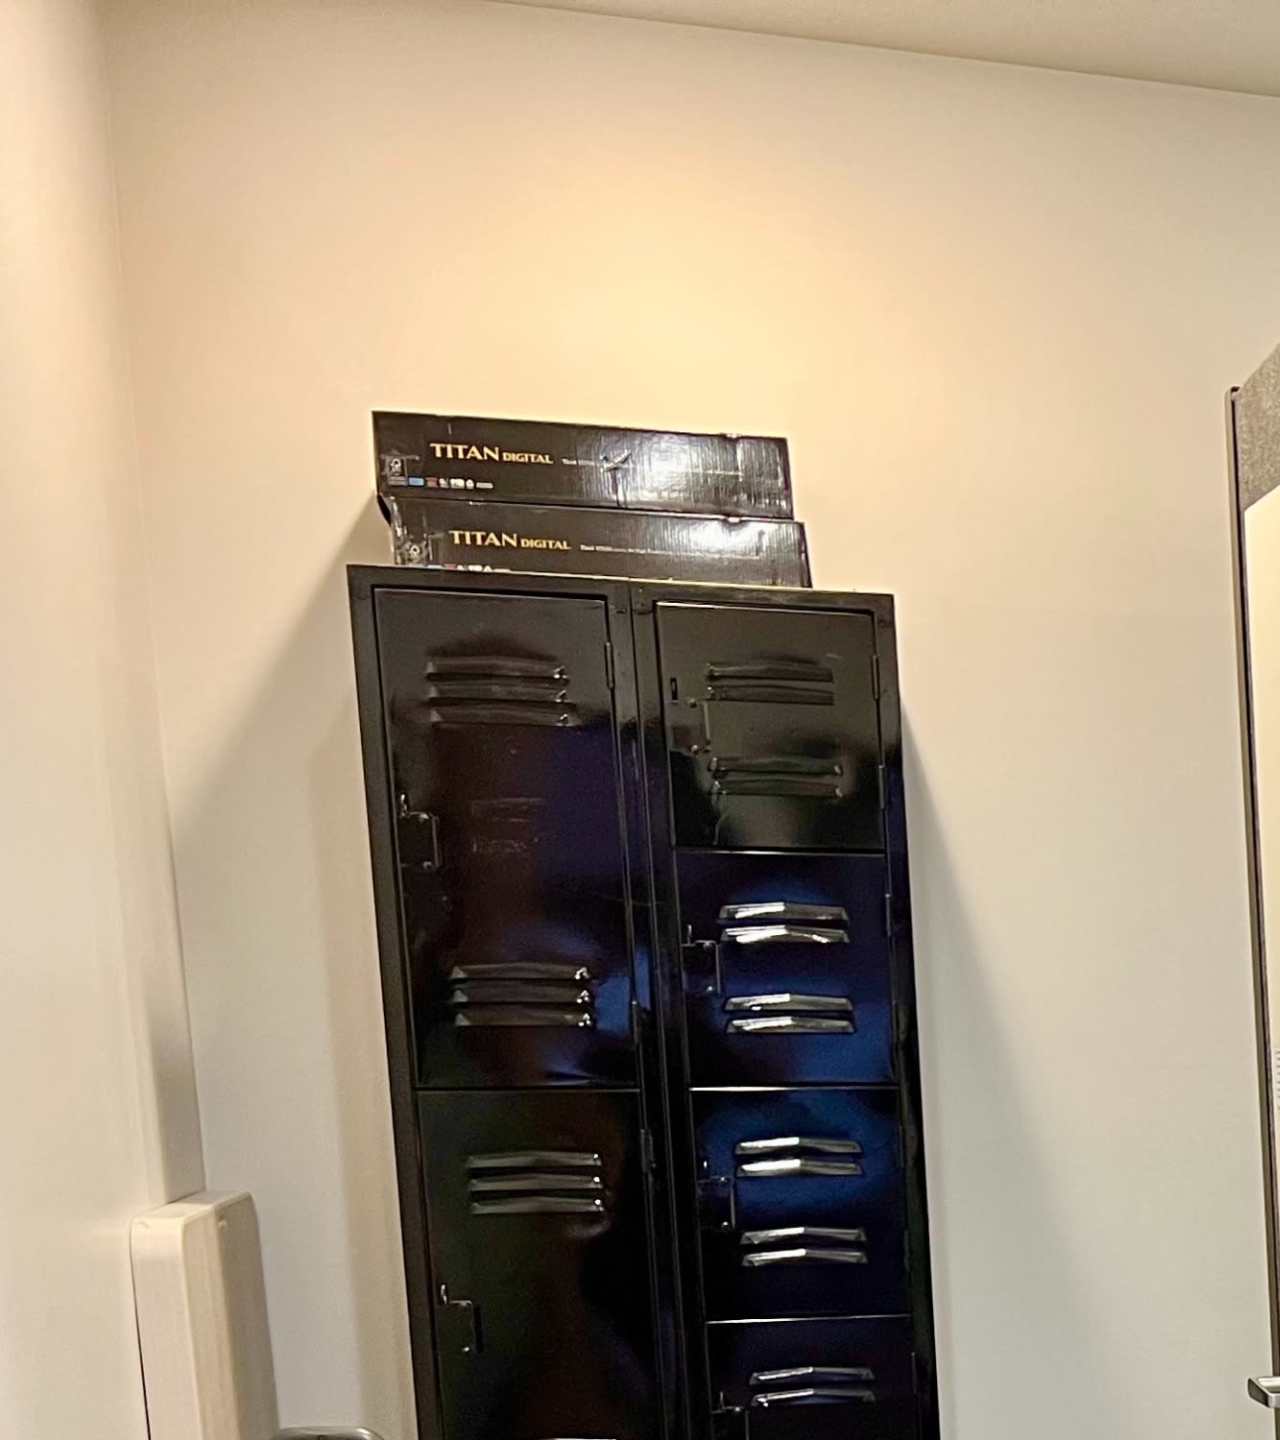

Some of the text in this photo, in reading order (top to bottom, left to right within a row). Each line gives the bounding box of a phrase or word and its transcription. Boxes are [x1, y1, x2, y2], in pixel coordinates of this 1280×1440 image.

[429, 443, 554, 464] TITAN DIGITAL
[448, 530, 572, 550] TITAN DIGITAL
